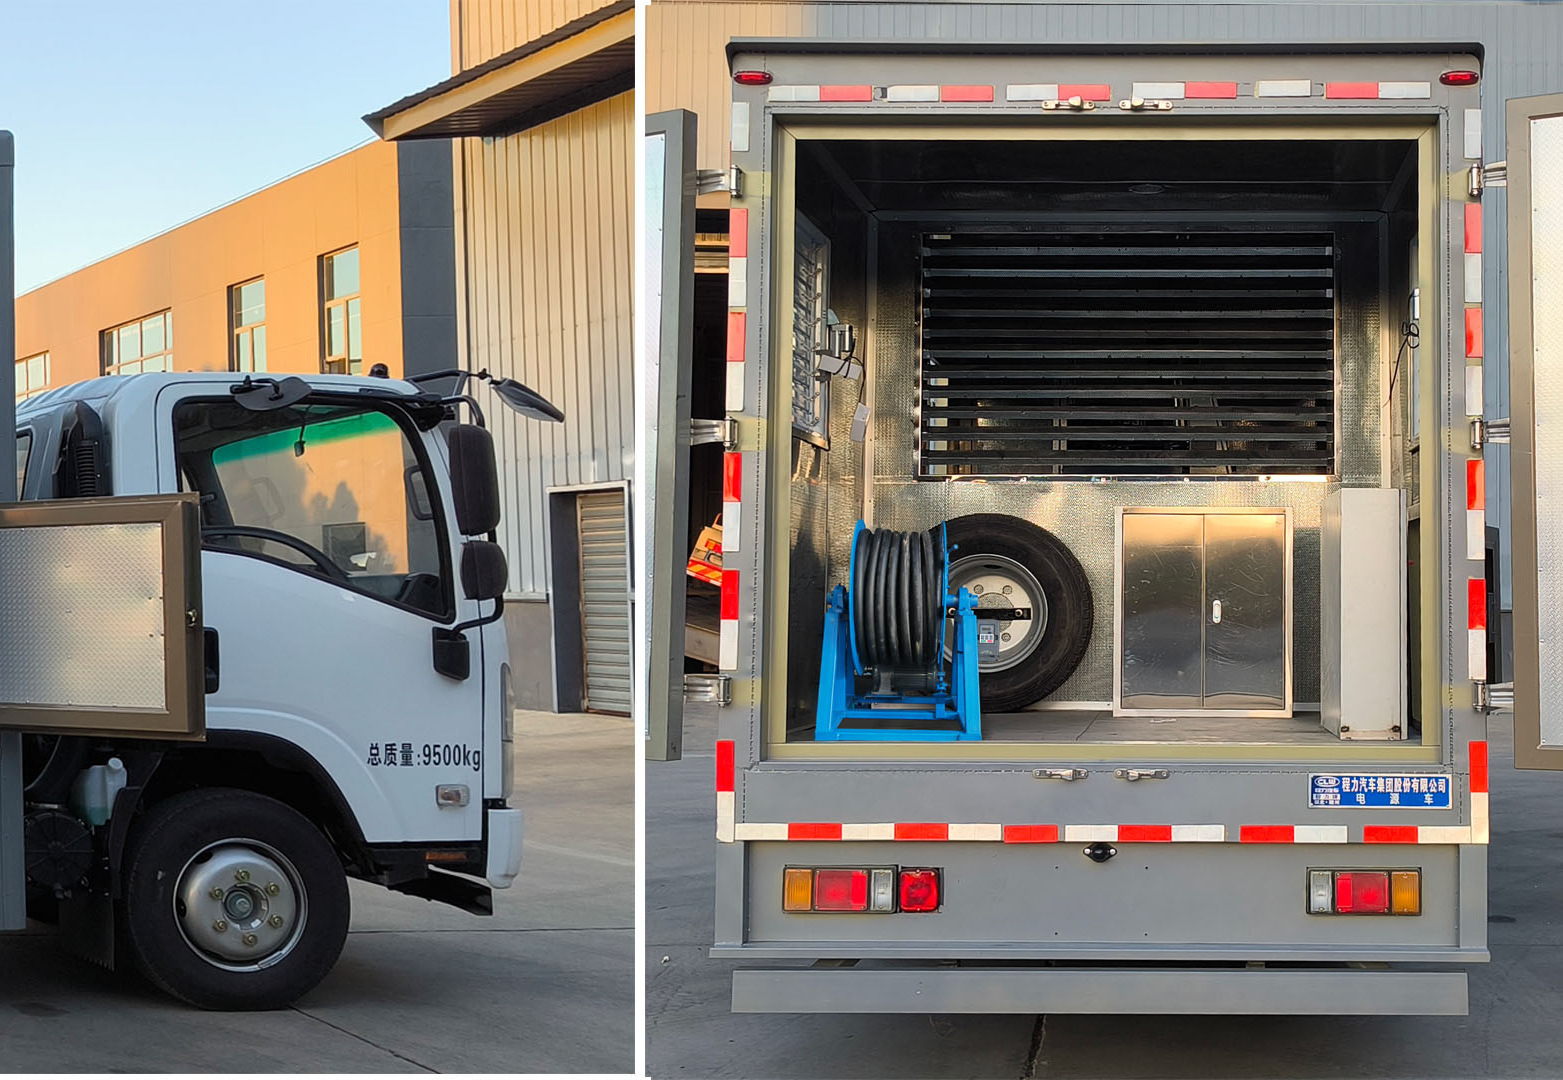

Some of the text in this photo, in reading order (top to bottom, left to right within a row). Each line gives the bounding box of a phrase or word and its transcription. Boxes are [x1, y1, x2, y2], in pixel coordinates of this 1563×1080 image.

[367, 742, 481, 772] 总质量:9500kg
[1341, 777, 1446, 793] 程力汽车集团股份有限公司
